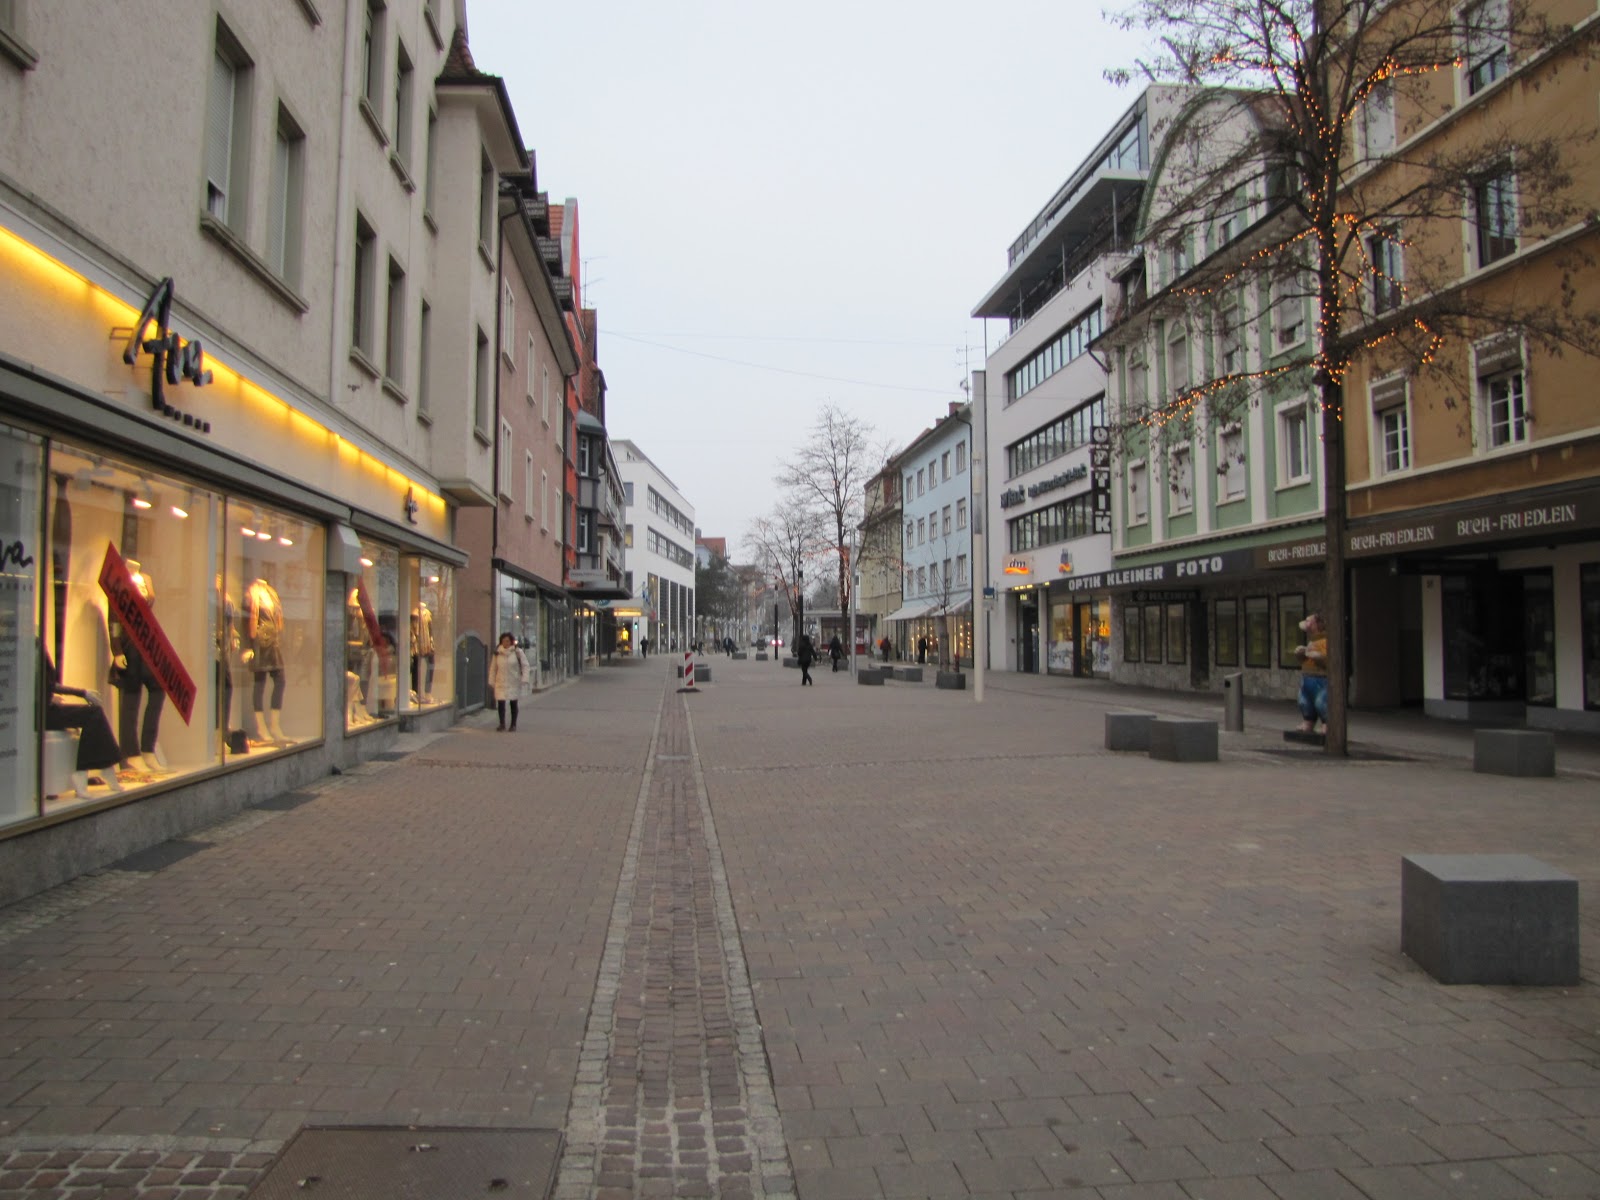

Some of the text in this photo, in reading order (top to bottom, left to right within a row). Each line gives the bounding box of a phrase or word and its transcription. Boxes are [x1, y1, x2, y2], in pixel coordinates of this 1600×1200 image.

[1268, 542, 1327, 562] BUCH-FRIEDLE
[1068, 556, 1223, 591] OPTIK KLEINER FOTO
